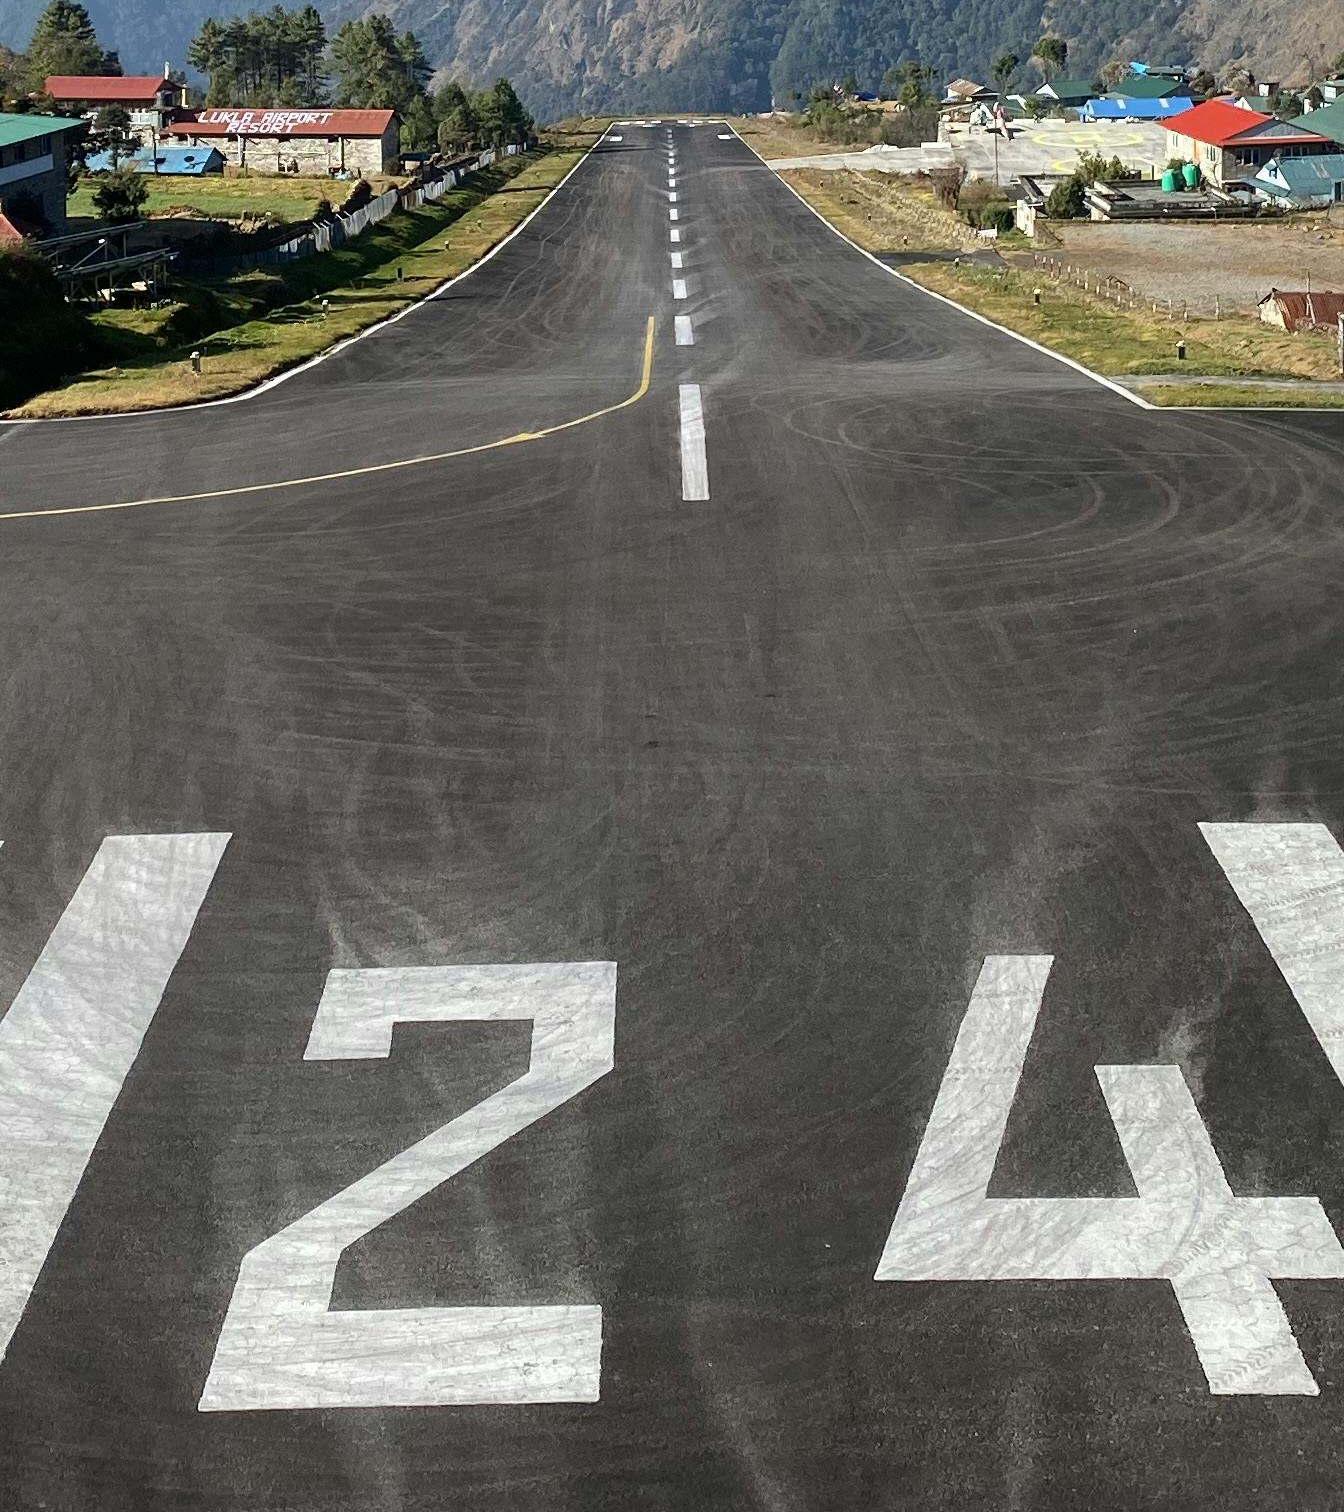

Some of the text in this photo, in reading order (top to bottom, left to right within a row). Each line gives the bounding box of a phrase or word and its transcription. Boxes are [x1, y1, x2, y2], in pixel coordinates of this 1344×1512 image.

[198, 111, 333, 124] LUKLA AIRPORT
[225, 122, 298, 134] RESORT
